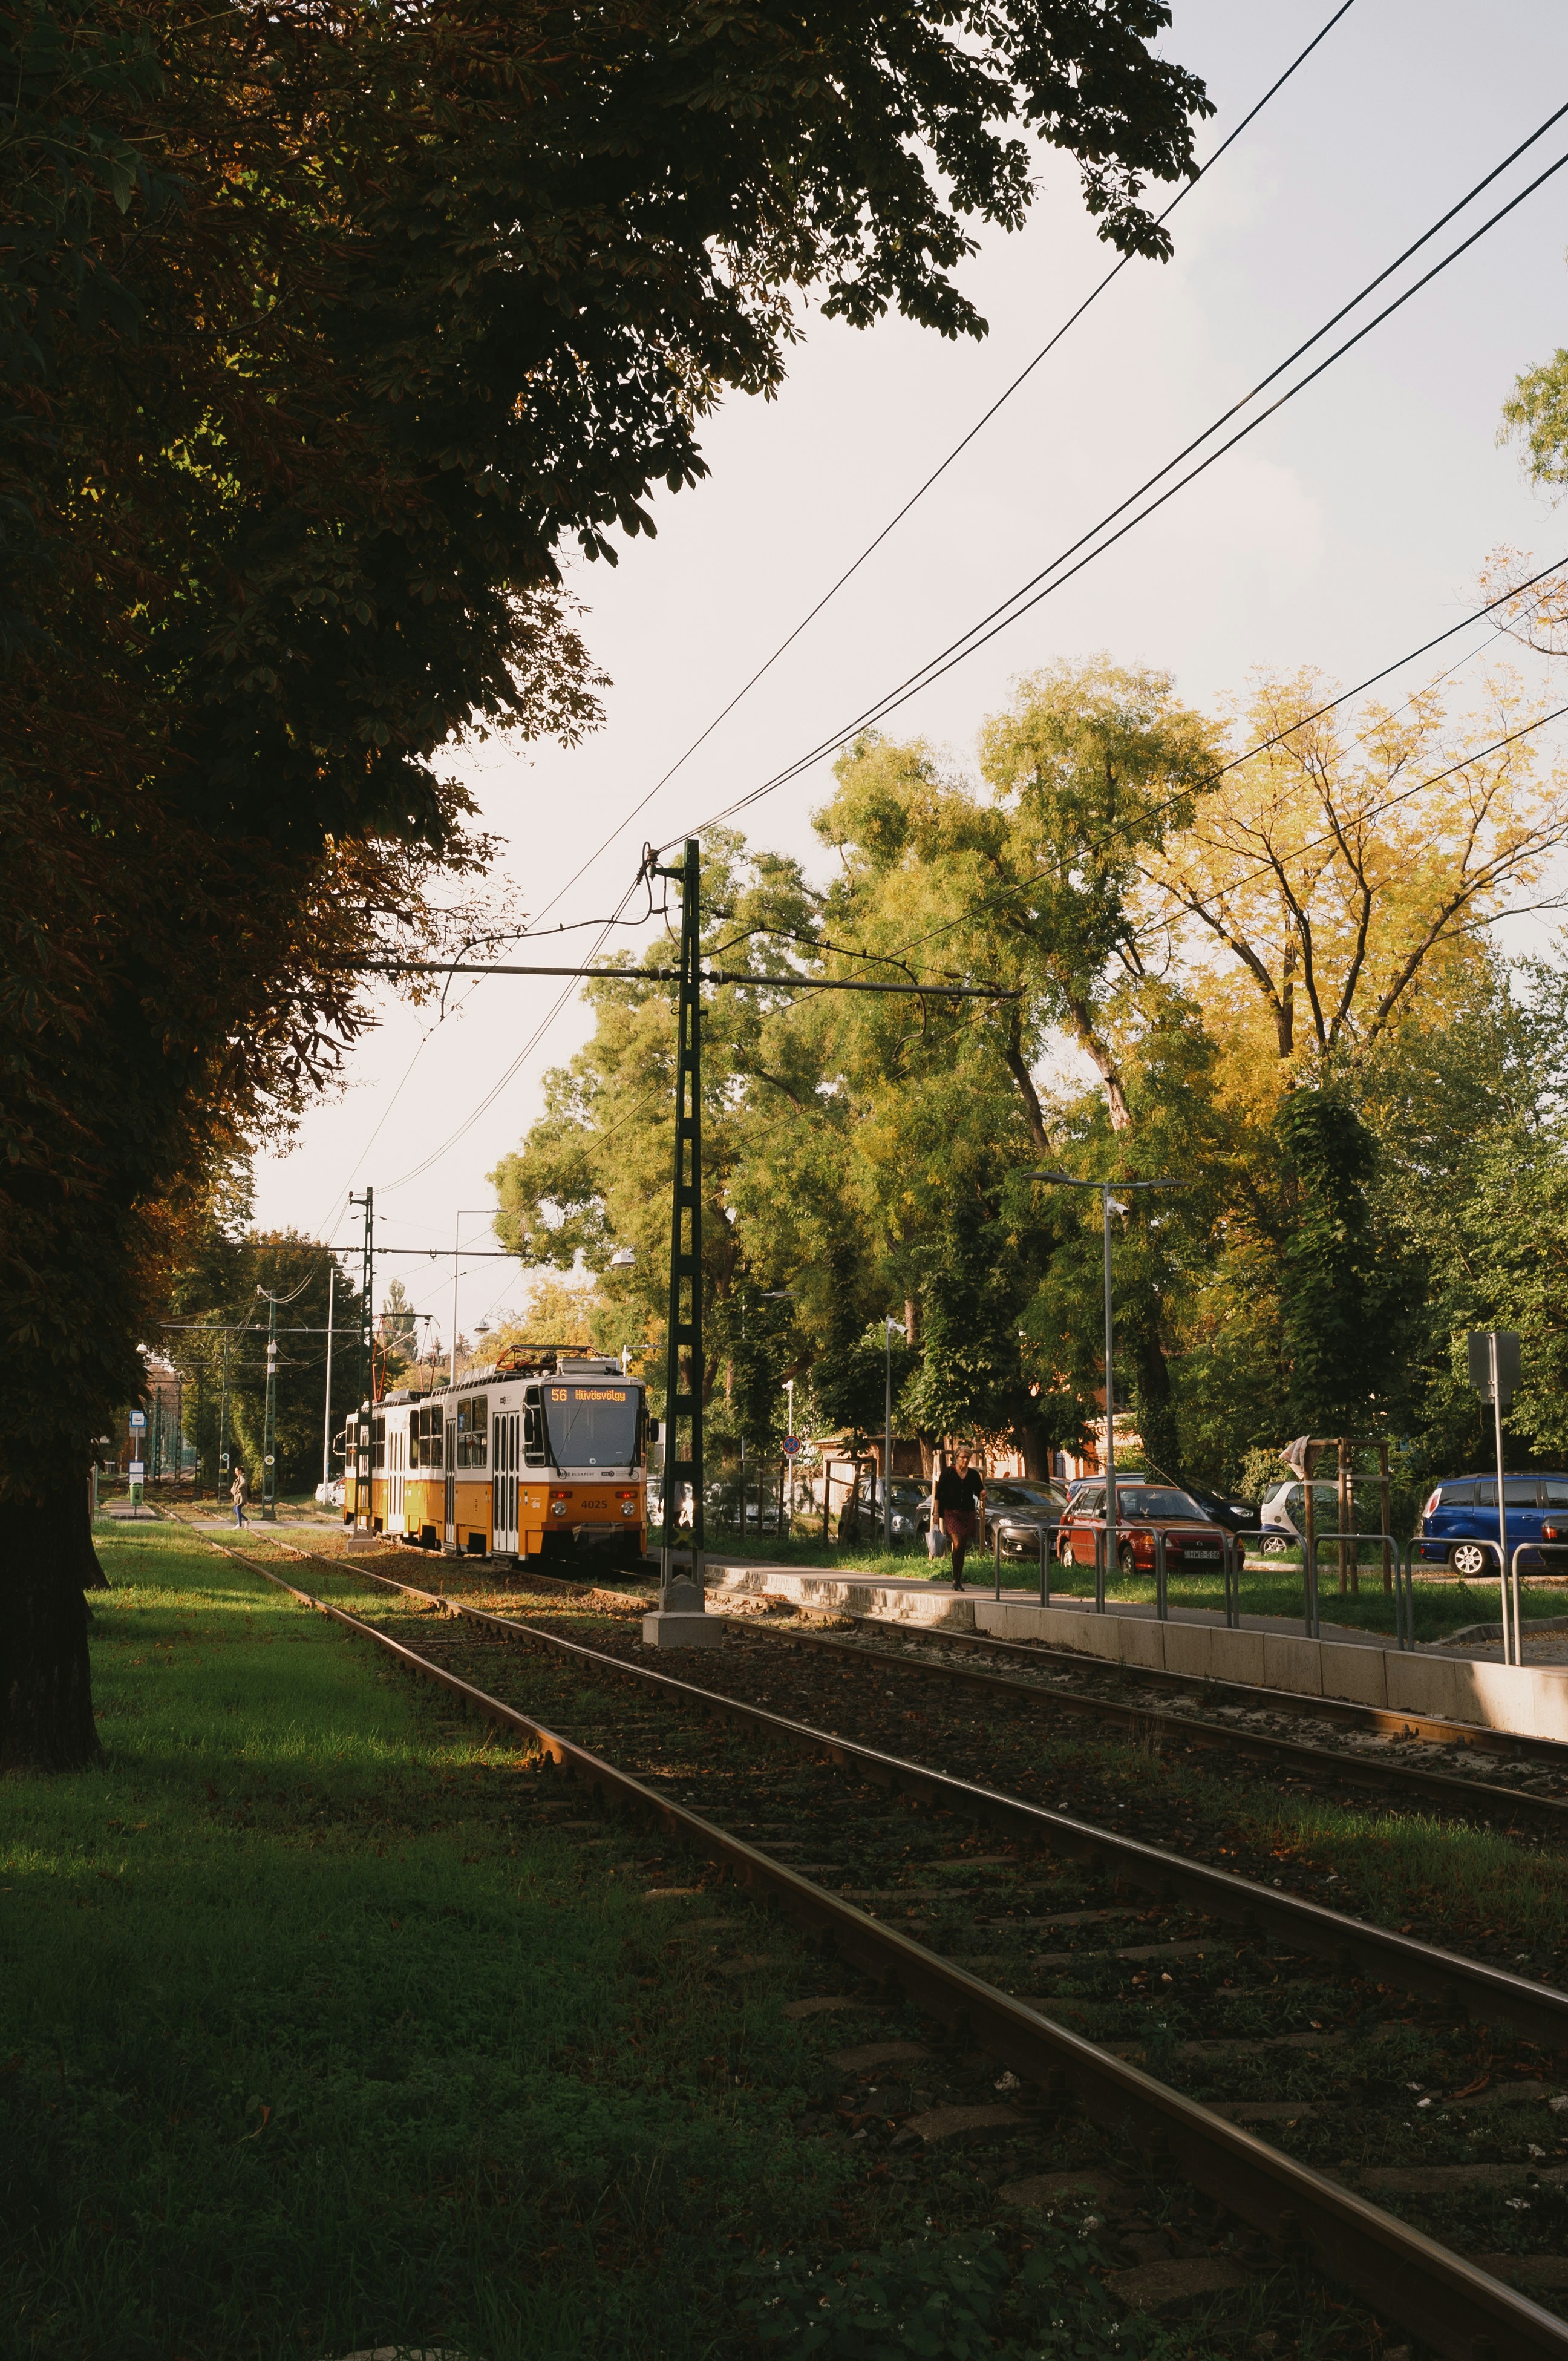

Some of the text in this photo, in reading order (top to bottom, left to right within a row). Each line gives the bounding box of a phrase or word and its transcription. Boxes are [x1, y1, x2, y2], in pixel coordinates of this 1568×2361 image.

[551, 1389, 626, 1401] 56 Hüvösvölgy
[581, 1500, 607, 1509] 4025
